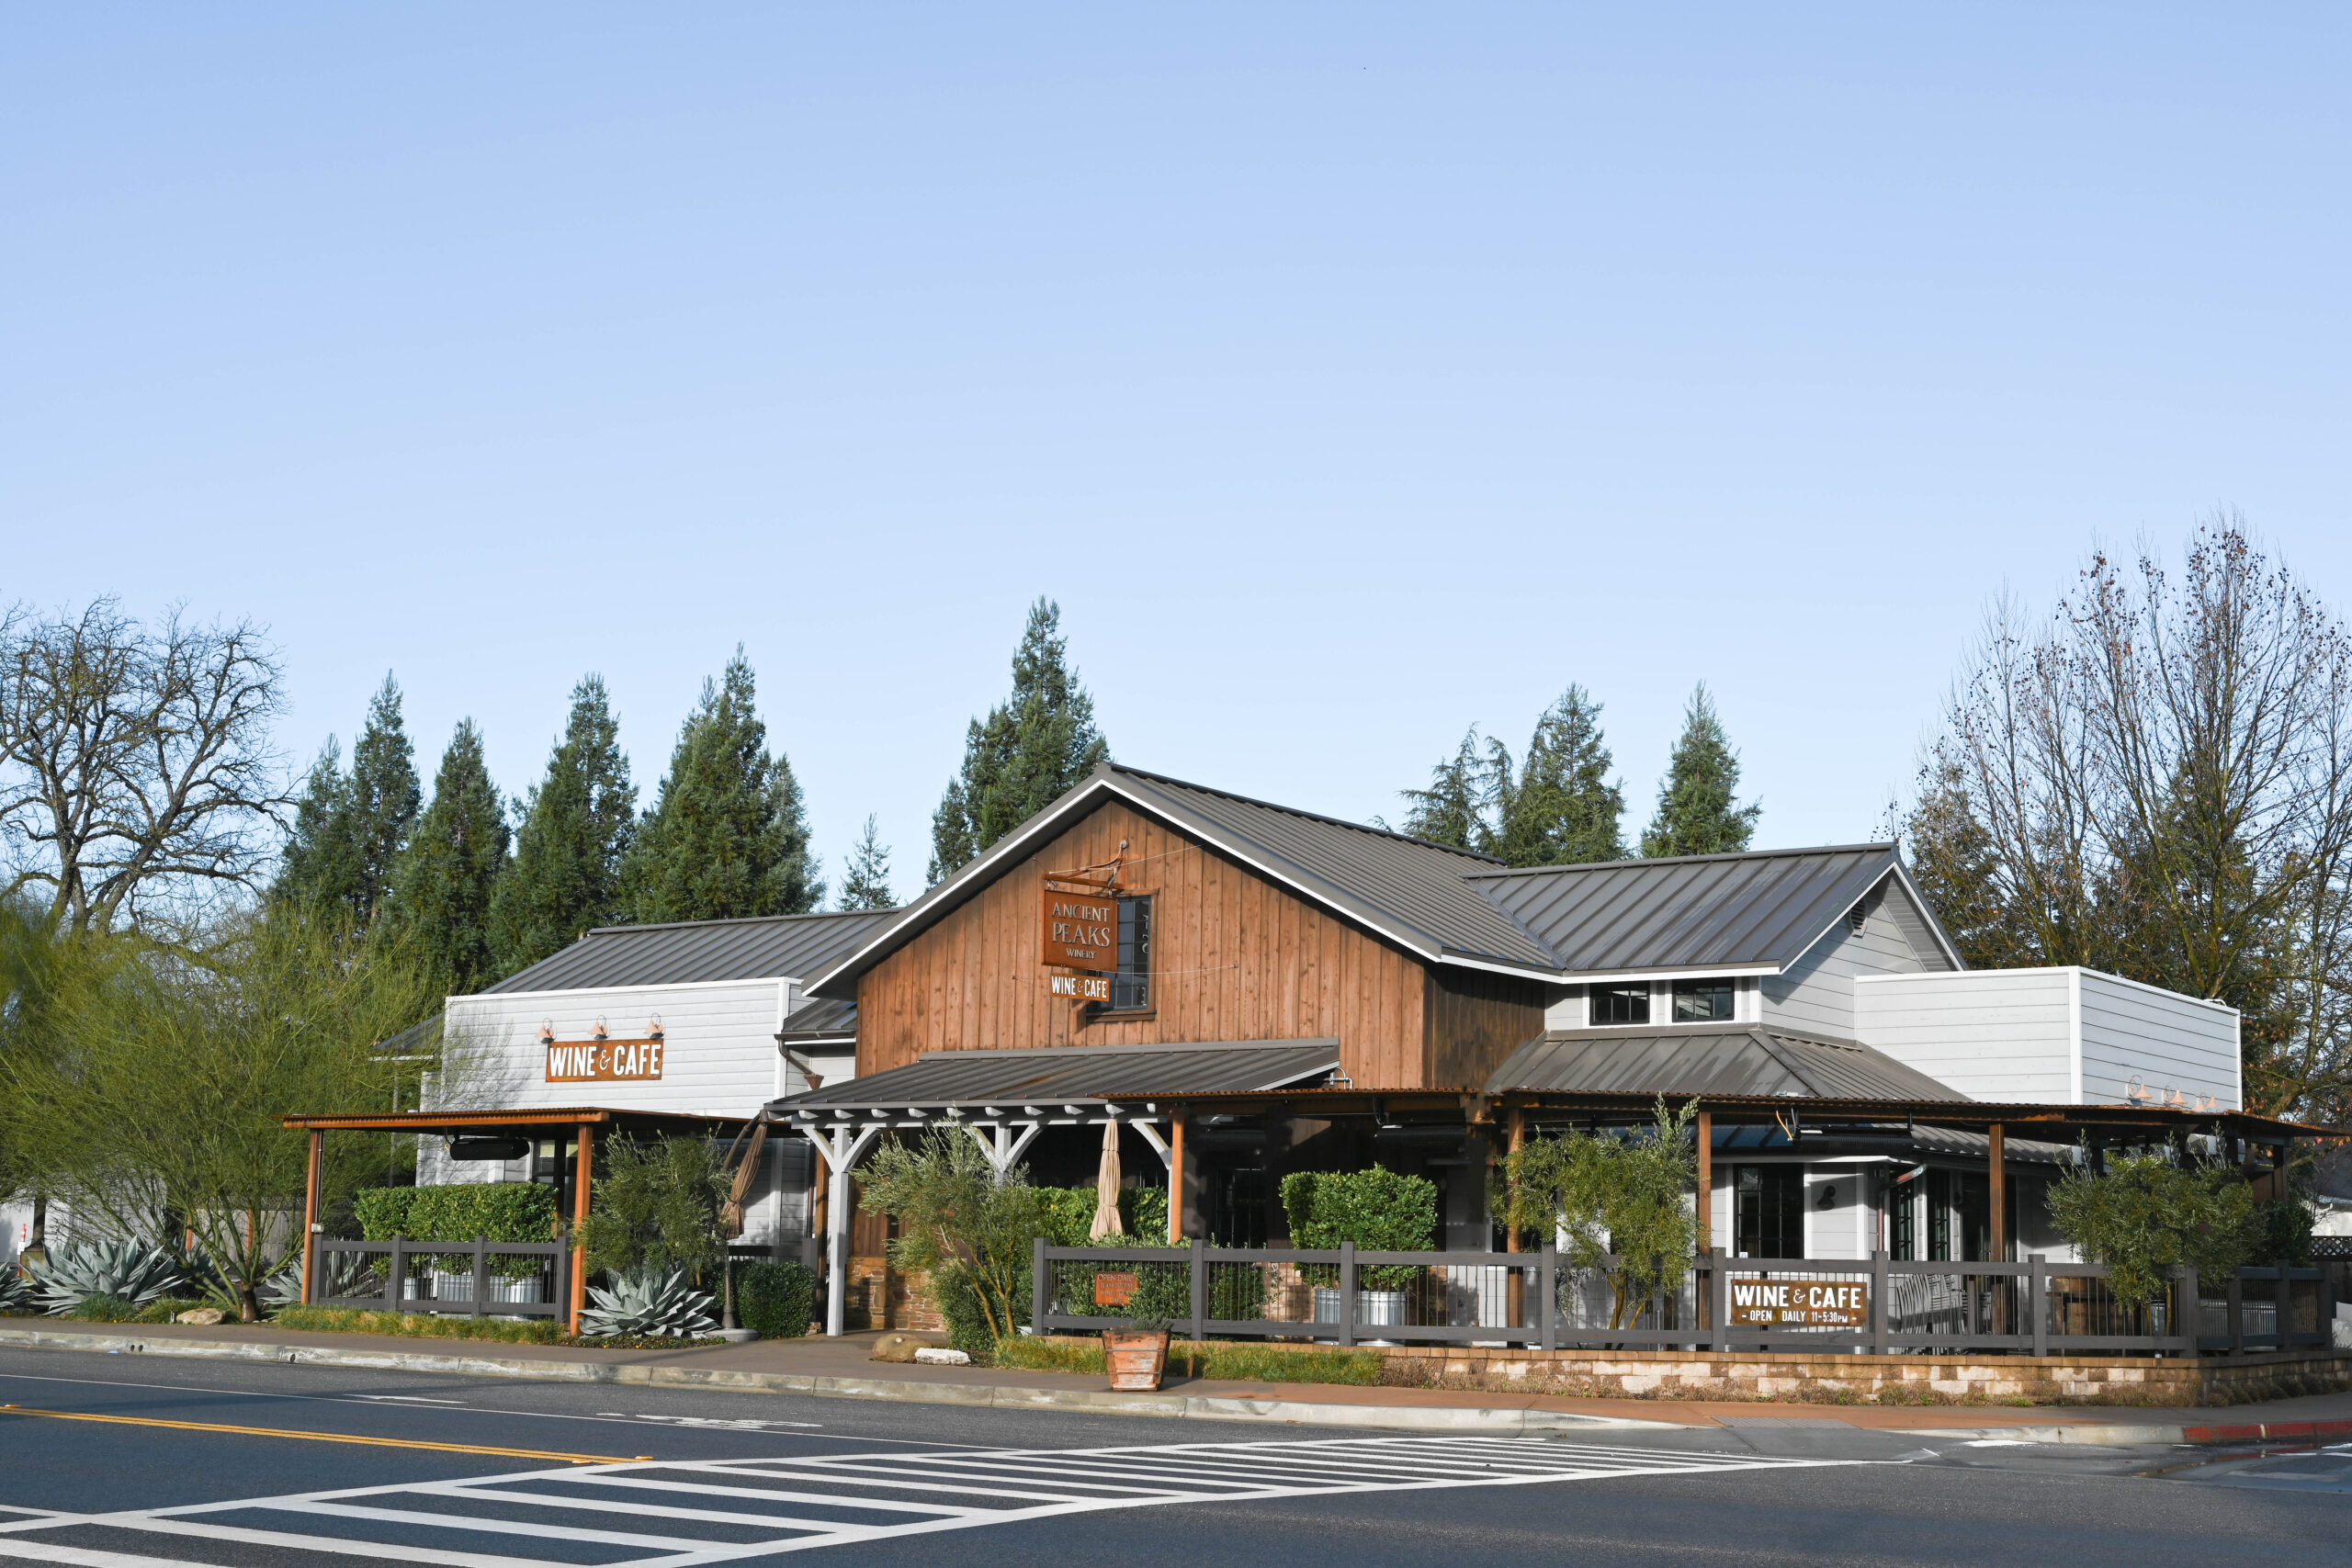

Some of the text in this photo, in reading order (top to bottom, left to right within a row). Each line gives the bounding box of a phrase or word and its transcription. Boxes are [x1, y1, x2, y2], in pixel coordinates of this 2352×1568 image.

[1052, 902, 1111, 923] ANCIENT
[1052, 922, 1111, 947] PEAKS
[1066, 947, 1096, 960] WINERY
[1051, 976, 1107, 998] WINE & CAFE
[549, 1043, 662, 1077] WINE & CAFE
[1734, 1285, 1861, 1309] WINE & CAFE
[1749, 1310, 1772, 1322] OPEN
[1781, 1311, 1806, 1322] DAILY
